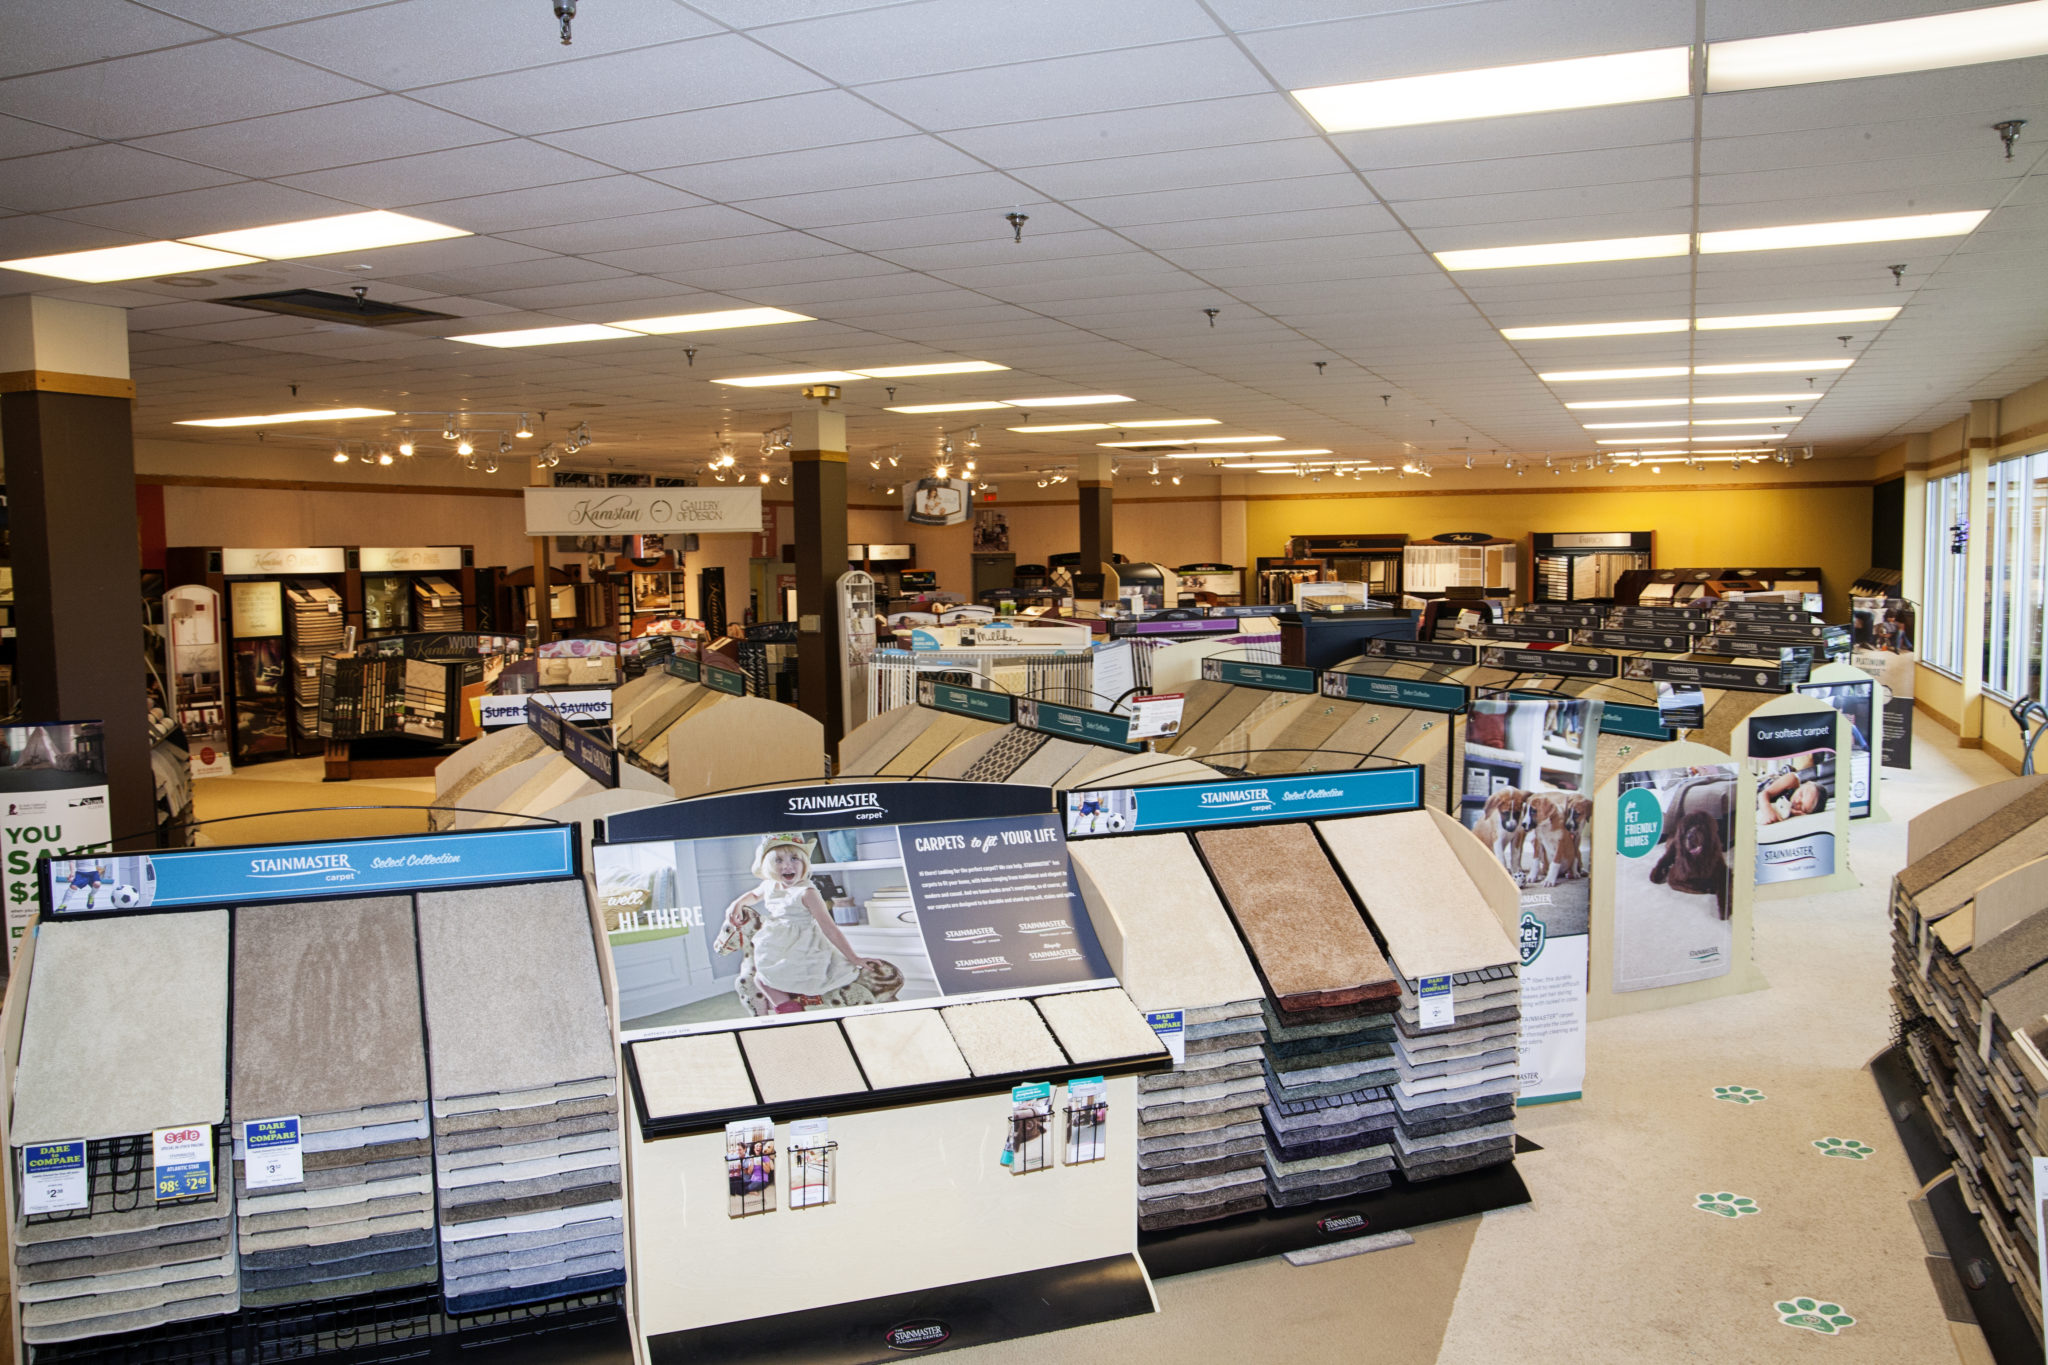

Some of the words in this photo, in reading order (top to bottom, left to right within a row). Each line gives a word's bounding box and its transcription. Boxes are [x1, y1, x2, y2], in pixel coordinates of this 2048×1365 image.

[680, 500, 719, 511] GALLERY
[568, 495, 642, 529] Karastan
[688, 510, 723, 522] DESIGN
[448, 635, 479, 649] WOOL
[485, 706, 520, 718] SUPER
[523, 704, 557, 716] SCK
[561, 702, 607, 714] SAVINGS
[1757, 730, 1773, 740] Our
[1774, 727, 1803, 739] softest
[1803, 726, 1830, 738] carpet
[789, 792, 880, 811] STAINMASTER
[1201, 788, 1270, 804] STAINMASTER
[1282, 790, 1307, 802] Select
[1307, 788, 1344, 799] Collection
[1251, 804, 1272, 812] carpet
[856, 811, 883, 821] carpet
[1625, 812, 1640, 823] PET
[5, 825, 61, 844] YOU
[1625, 822, 1657, 835] FRIENDLY
[915, 835, 966, 852] CARPETS
[970, 836, 982, 848] to
[981, 835, 999, 853] fit
[1001, 829, 1033, 845] YOUR
[1034, 827, 1058, 843] LIFE
[1624, 835, 1649, 847] HOMES
[251, 854, 351, 873] STAINMASTER
[370, 856, 404, 869] Select
[406, 852, 462, 867] Collection
[325, 872, 355, 882] carpet
[607, 891, 645, 906] well,
[618, 912, 638, 931] HI
[644, 905, 705, 930] THERE
[1018, 919, 1068, 931] STAINMASTER
[945, 926, 997, 938] STAINMASTER
[1029, 948, 1079, 960] STAINMASTER
[955, 956, 1008, 968] STAINMASTER
[1521, 1013, 1556, 1023] TAINMASTER
[259, 1122, 286, 1131] DARE
[166, 1130, 199, 1143] sale
[249, 1132, 296, 1142] COMPARE
[40, 1145, 70, 1155] DARE
[29, 1155, 81, 1167] COMPARE
[894, 1326, 942, 1340] STAINMASTER
